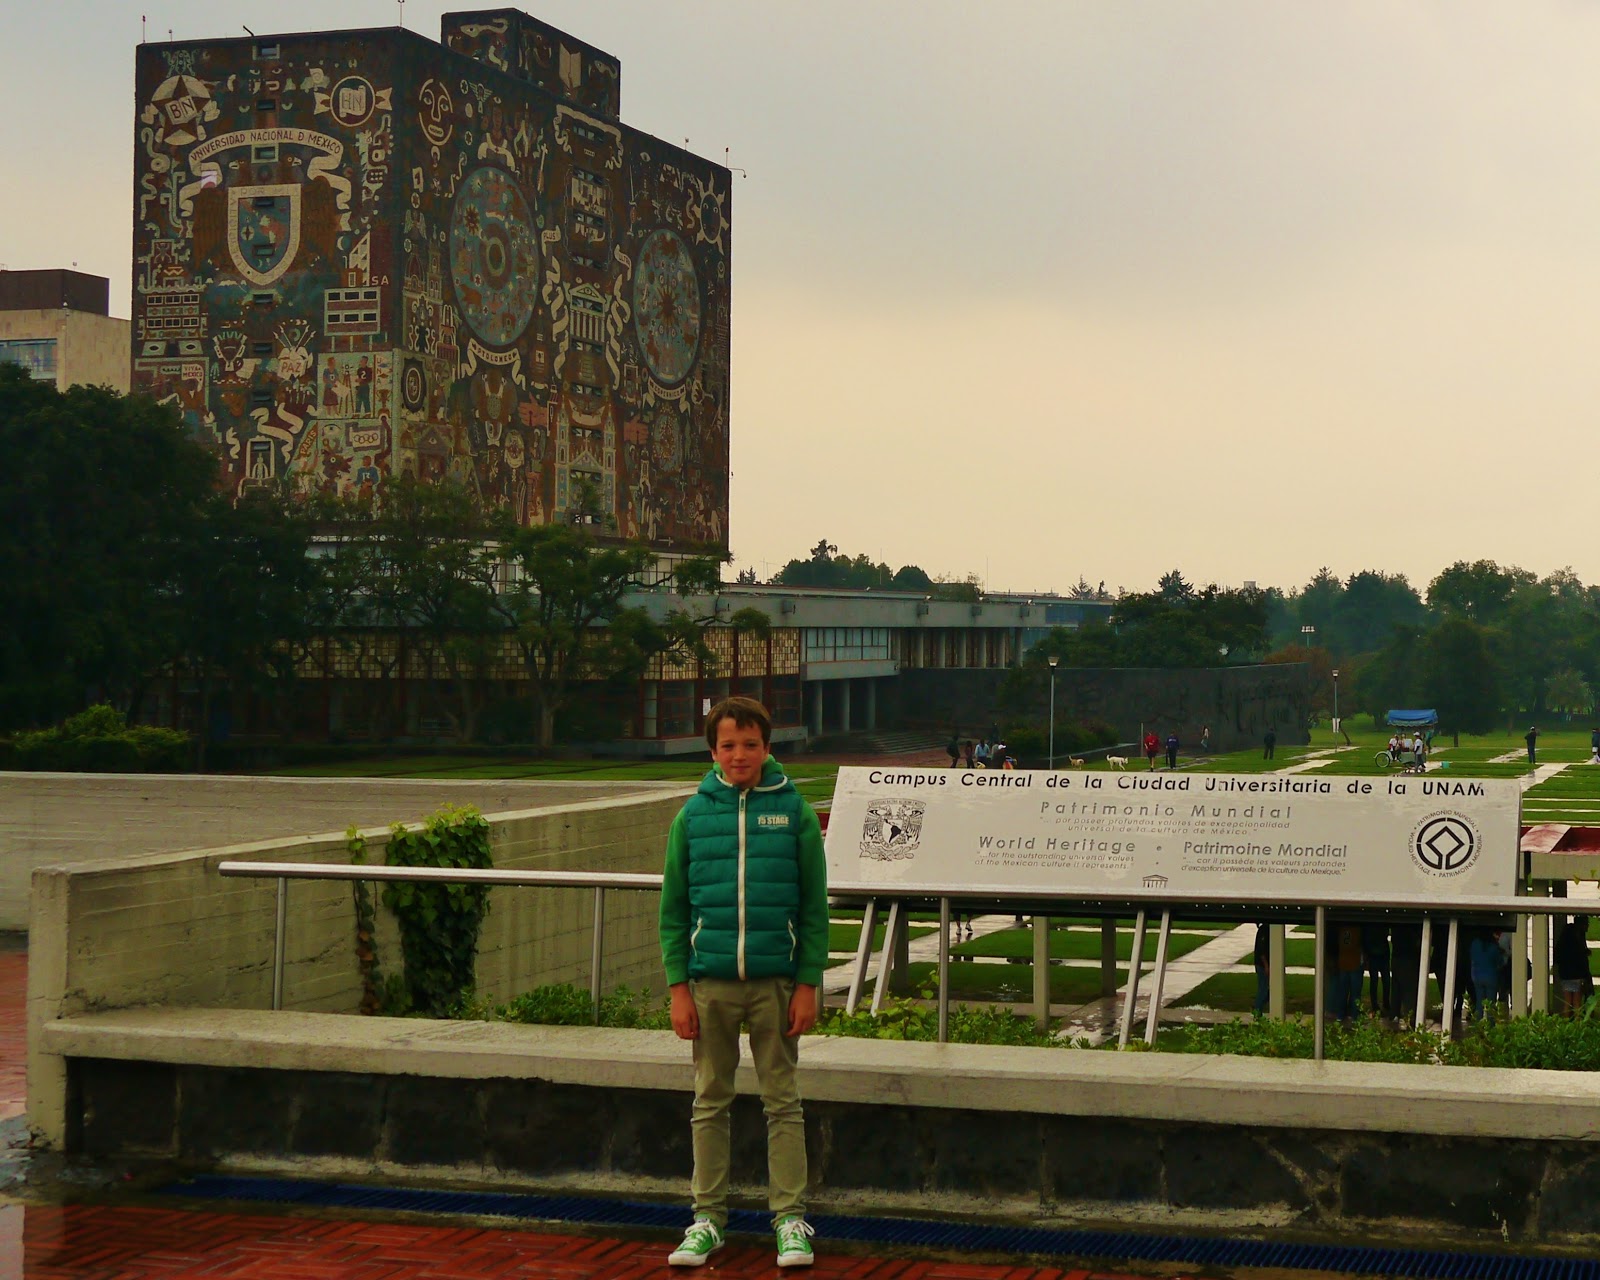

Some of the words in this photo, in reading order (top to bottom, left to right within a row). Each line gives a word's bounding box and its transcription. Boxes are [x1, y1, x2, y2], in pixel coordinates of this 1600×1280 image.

[170, 98, 195, 118] BN
[250, 130, 294, 142] NACIONAL
[307, 133, 341, 154] MEXICO
[543, 232, 556, 240] PLUS
[281, 362, 302, 373] PAZ
[300, 430, 317, 455] PARIS
[869, 771, 947, 788] Campus
[961, 773, 1032, 787] Central
[1046, 775, 1070, 788] de
[1084, 775, 1102, 789] la
[1117, 775, 1190, 791] Ciudad
[1205, 777, 1331, 793] Universitaria
[1346, 780, 1373, 794] de
[1388, 781, 1406, 795] la
[1422, 782, 1485, 796] UNAM
[1041, 801, 1174, 816] Patrimonio
[1191, 805, 1291, 818] Mundial
[767, 816, 789, 825] STAGE
[1108, 818, 1154, 827] profundos
[1158, 819, 1191, 827] valores
[1210, 820, 1290, 829] excepcionalidad
[1417, 809, 1452, 827] PATRIMONIO
[1454, 811, 1477, 829] MUNDIAL
[1150, 826, 1188, 834] cultura
[979, 836, 1036, 849] World
[1046, 838, 1136, 854] Heritage
[1184, 842, 1272, 856] Patrimoine
[1278, 844, 1347, 857] Mondial
[1017, 852, 1066, 861] outstanding
[1041, 860, 1071, 868] culture
[1275, 866, 1298, 874] culture
[1438, 861, 1473, 878] PATRIMOINE
